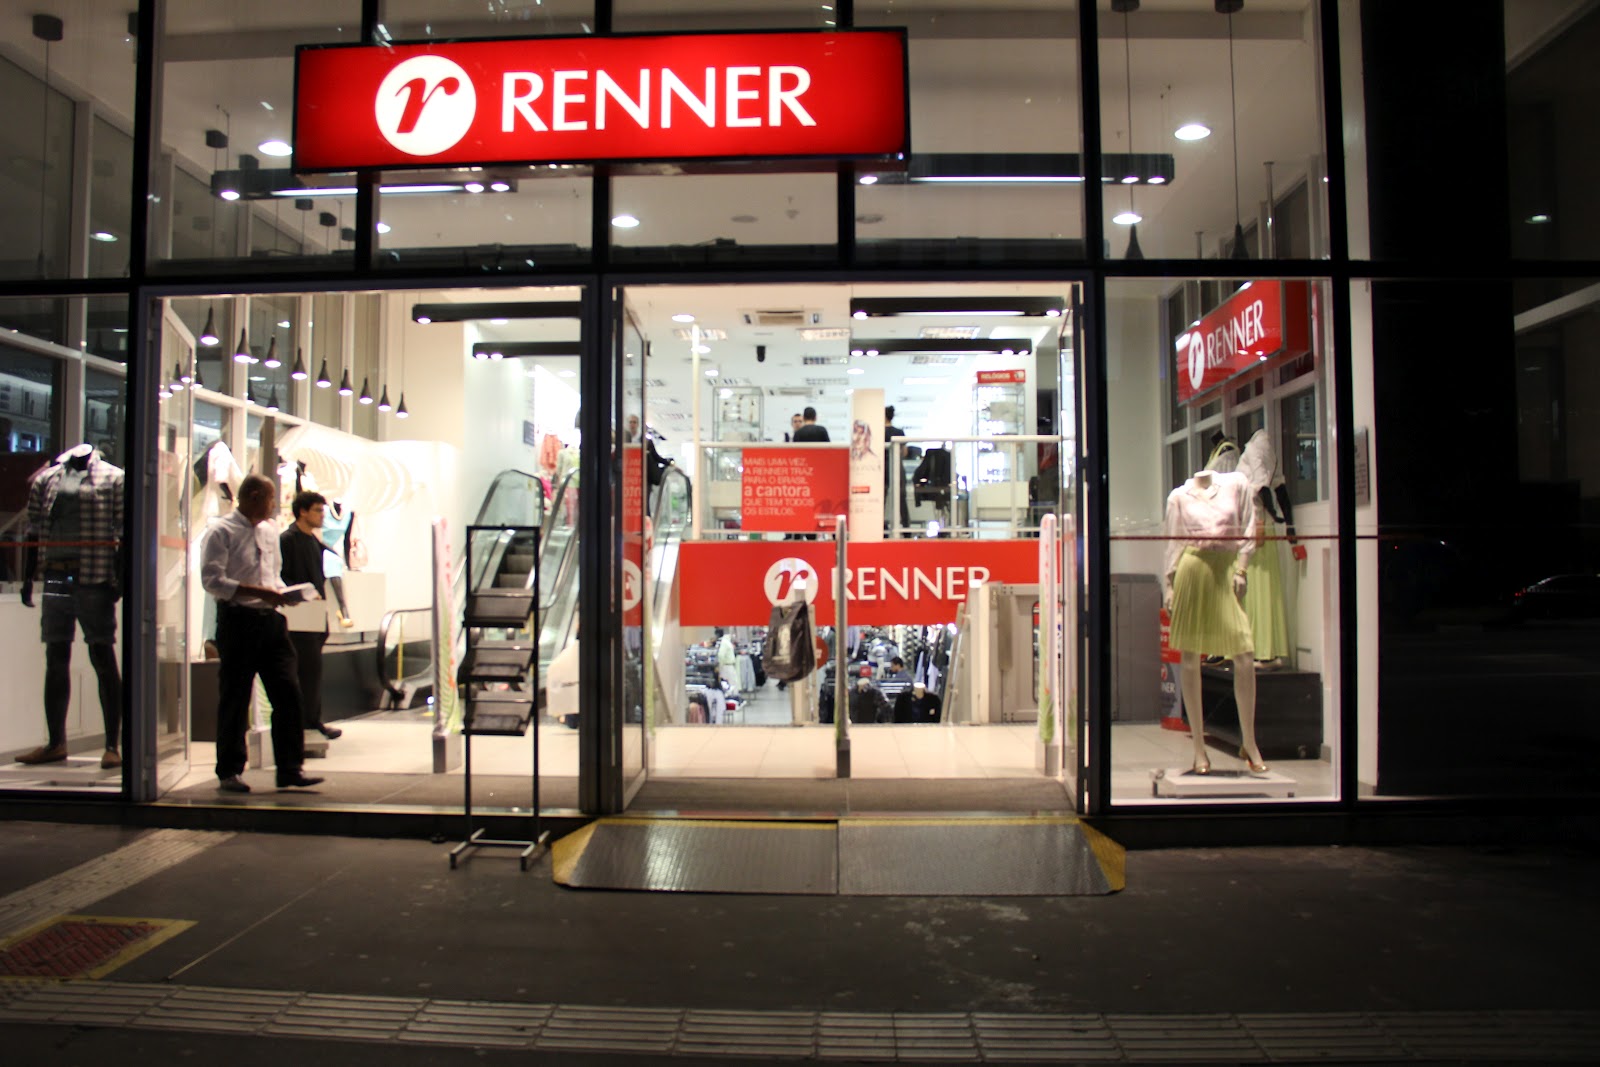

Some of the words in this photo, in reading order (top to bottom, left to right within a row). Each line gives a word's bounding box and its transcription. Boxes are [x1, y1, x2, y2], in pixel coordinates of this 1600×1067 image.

[501, 64, 817, 132] RENNER
[1206, 299, 1265, 370] RENNER
[744, 457, 766, 466] MAIS
[767, 457, 786, 466] UMA
[744, 467, 751, 475] A
[752, 467, 788, 475] RENNER
[790, 467, 813, 476] TRAZ
[744, 476, 766, 484] PARA
[768, 476, 776, 484] O
[777, 476, 808, 484] BRASIL
[744, 485, 753, 497] a
[756, 485, 811, 497] cantora
[744, 498, 763, 507] QUE
[765, 498, 783, 507] TEM
[785, 498, 815, 507] TODOS
[744, 507, 757, 516] OS
